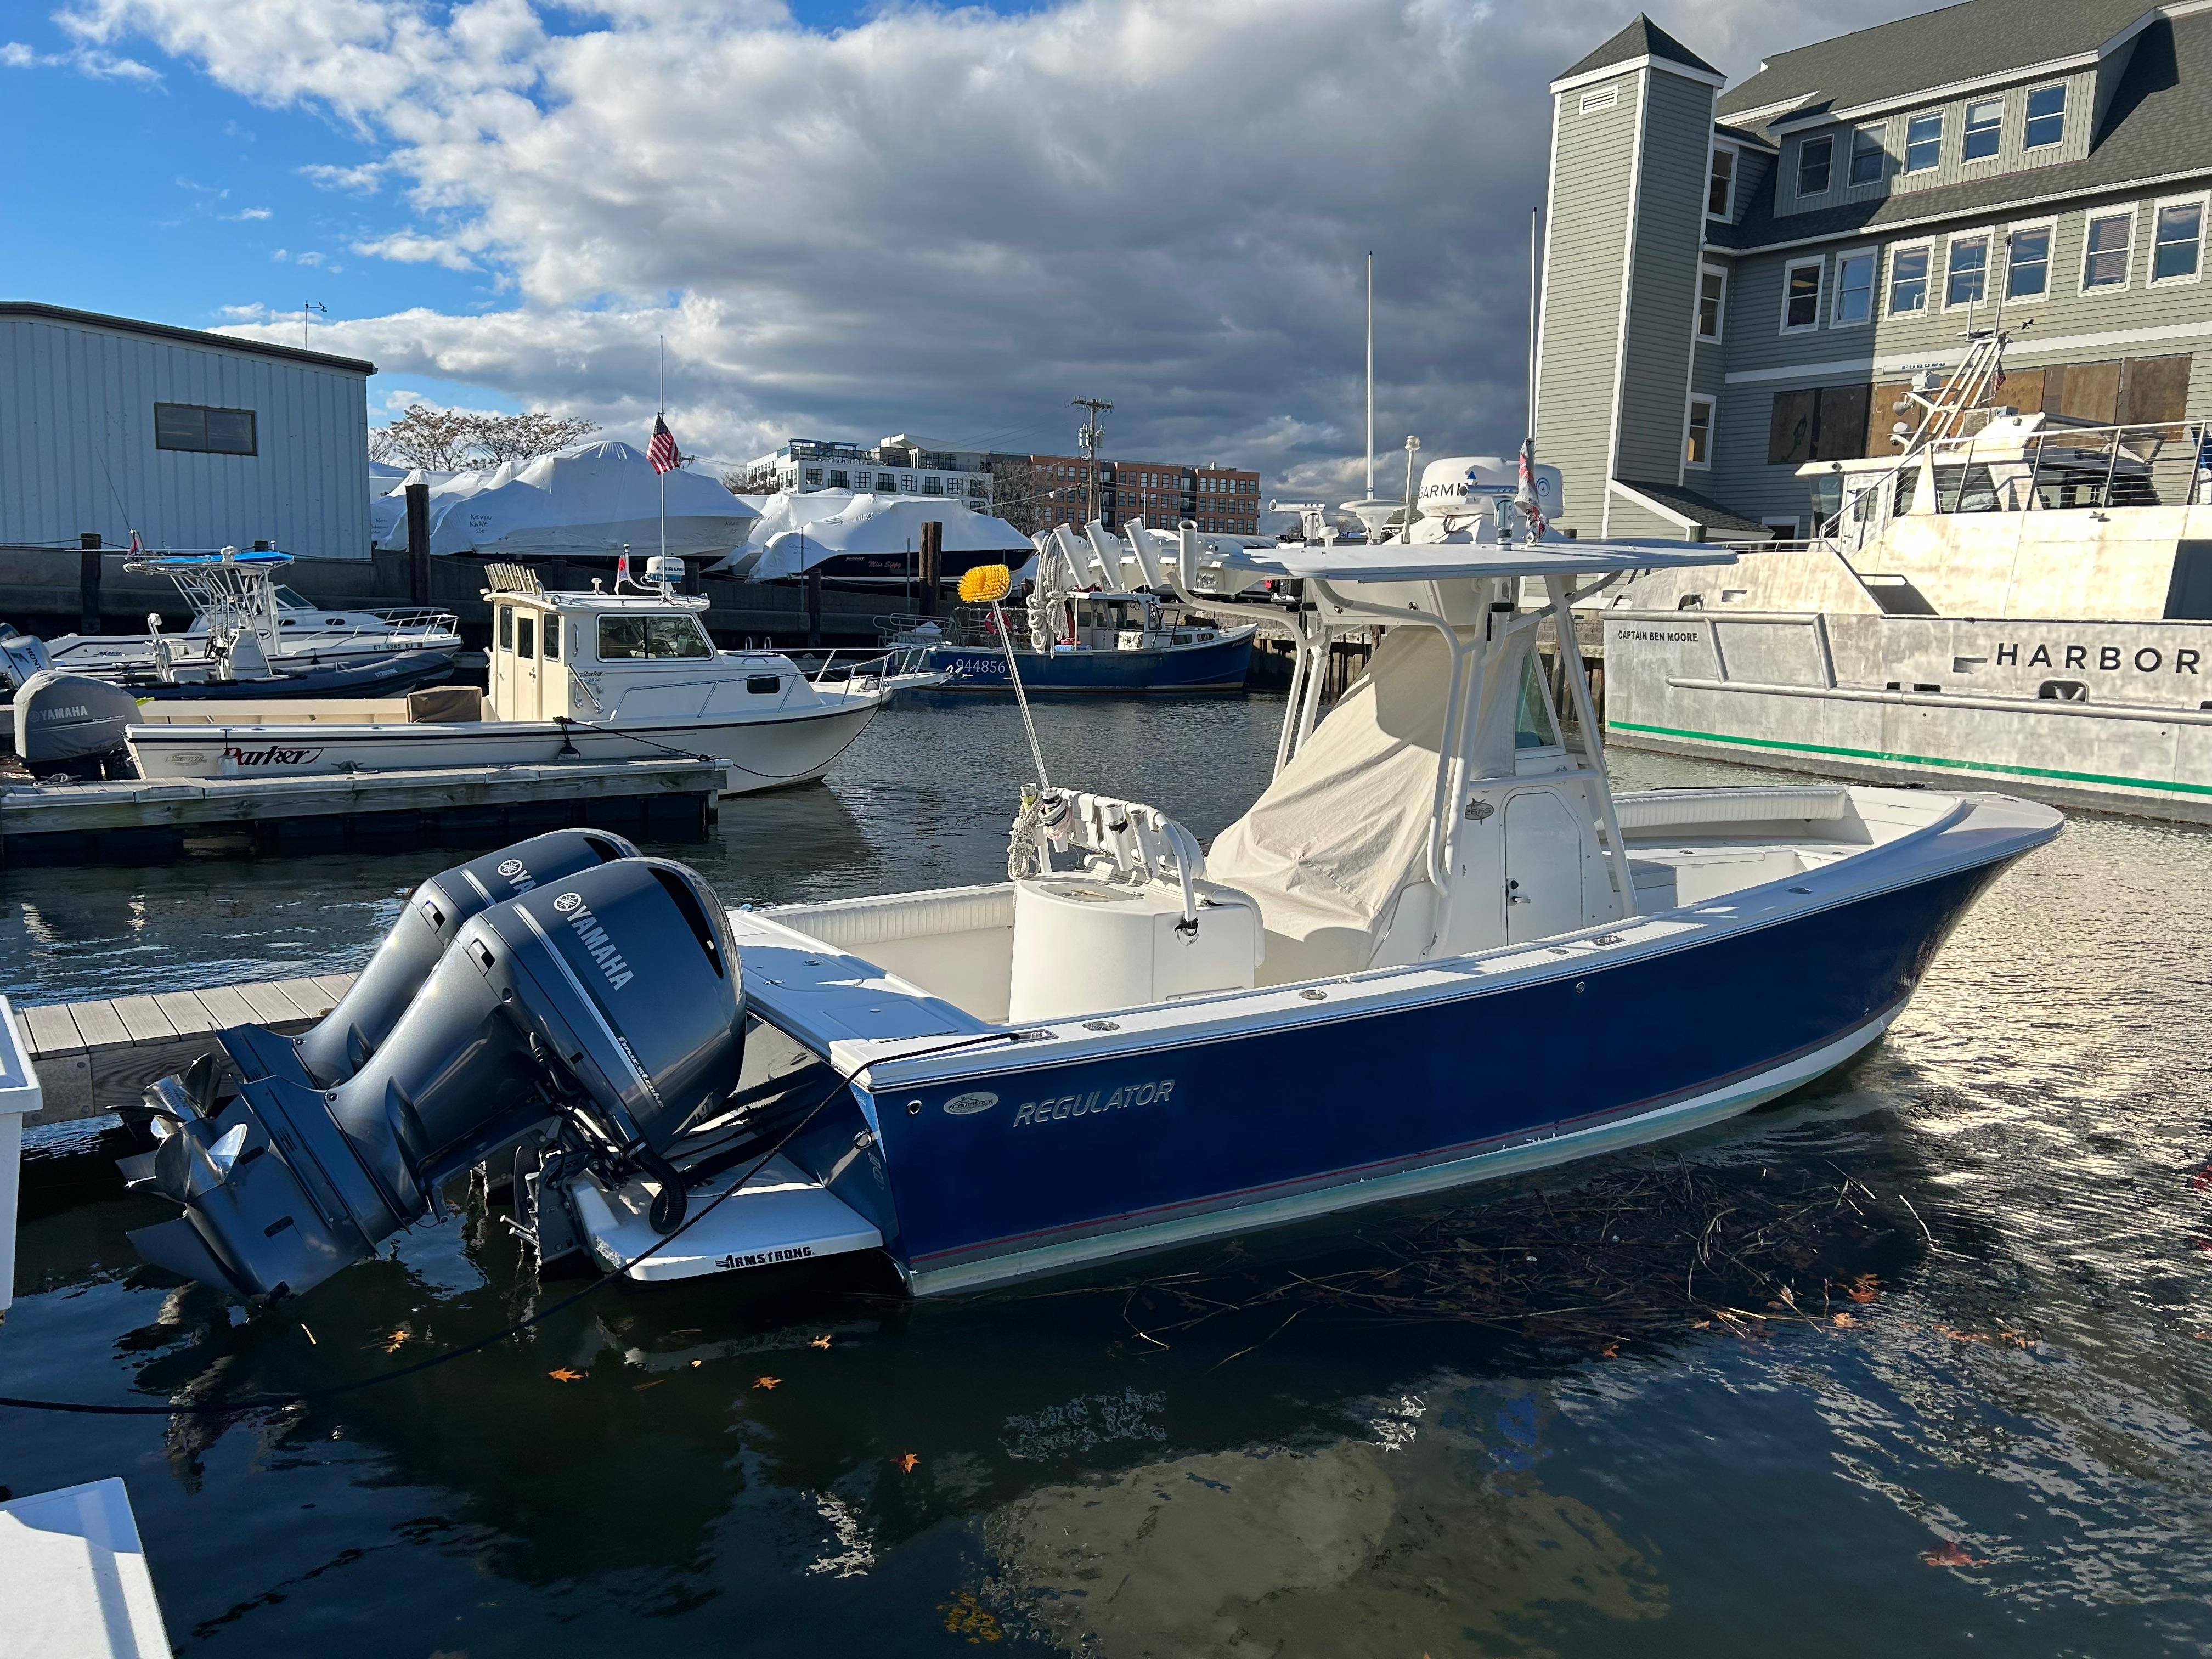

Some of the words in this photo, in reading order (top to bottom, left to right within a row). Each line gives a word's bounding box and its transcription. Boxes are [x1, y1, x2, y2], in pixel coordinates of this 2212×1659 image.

[1419, 483, 1468, 499] GARMI
[1618, 630, 1647, 641] CAPTAIN
[1649, 632, 1664, 641] BEN
[1667, 632, 1698, 642] MOORE
[26, 647, 43, 671] HOND
[956, 659, 1006, 673] 944856
[1997, 642, 2200, 675] HARBOR
[39, 706, 88, 720] YAMAHA
[223, 746, 311, 765] Parker
[509, 870, 537, 895] YA
[566, 904, 634, 991] YAMAHA
[1013, 1079, 1175, 1127] REGULATOR
[715, 1246, 812, 1268] ARMSTRONG
